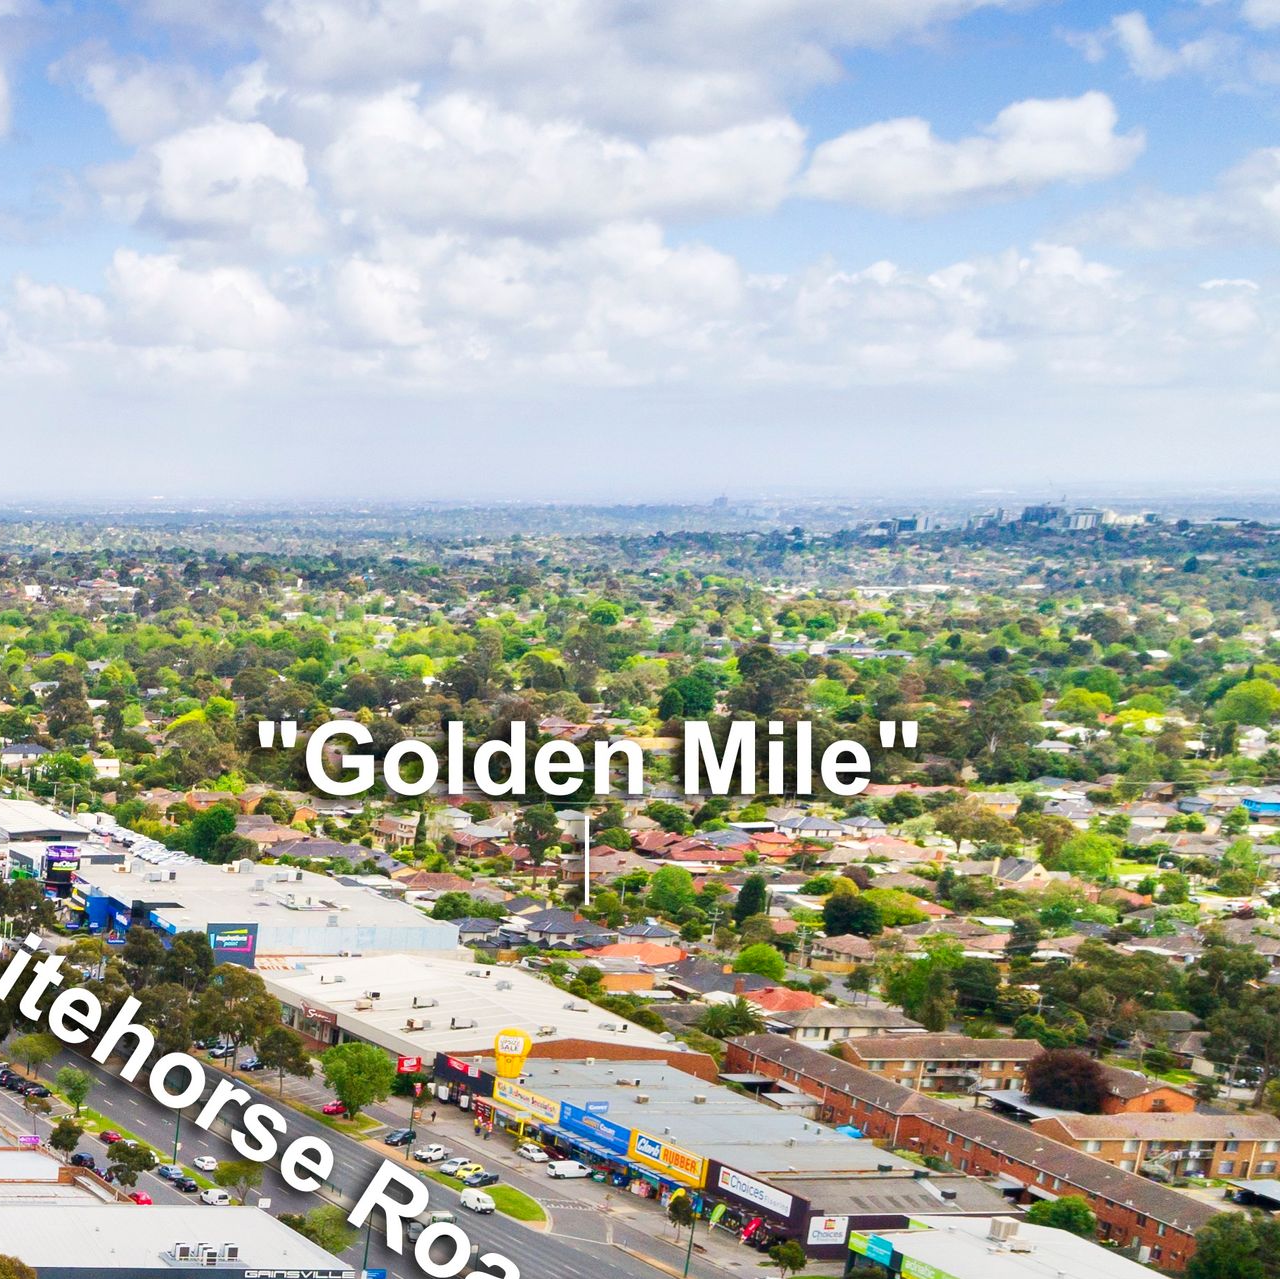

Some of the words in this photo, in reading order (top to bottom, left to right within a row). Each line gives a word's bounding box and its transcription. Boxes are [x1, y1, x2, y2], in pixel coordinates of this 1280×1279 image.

[663, 1149, 697, 1174] RUBBER
[730, 1174, 765, 1200] Choices
[812, 1230, 844, 1239] Choices
[244, 1270, 355, 1279] GAINSVILLE
